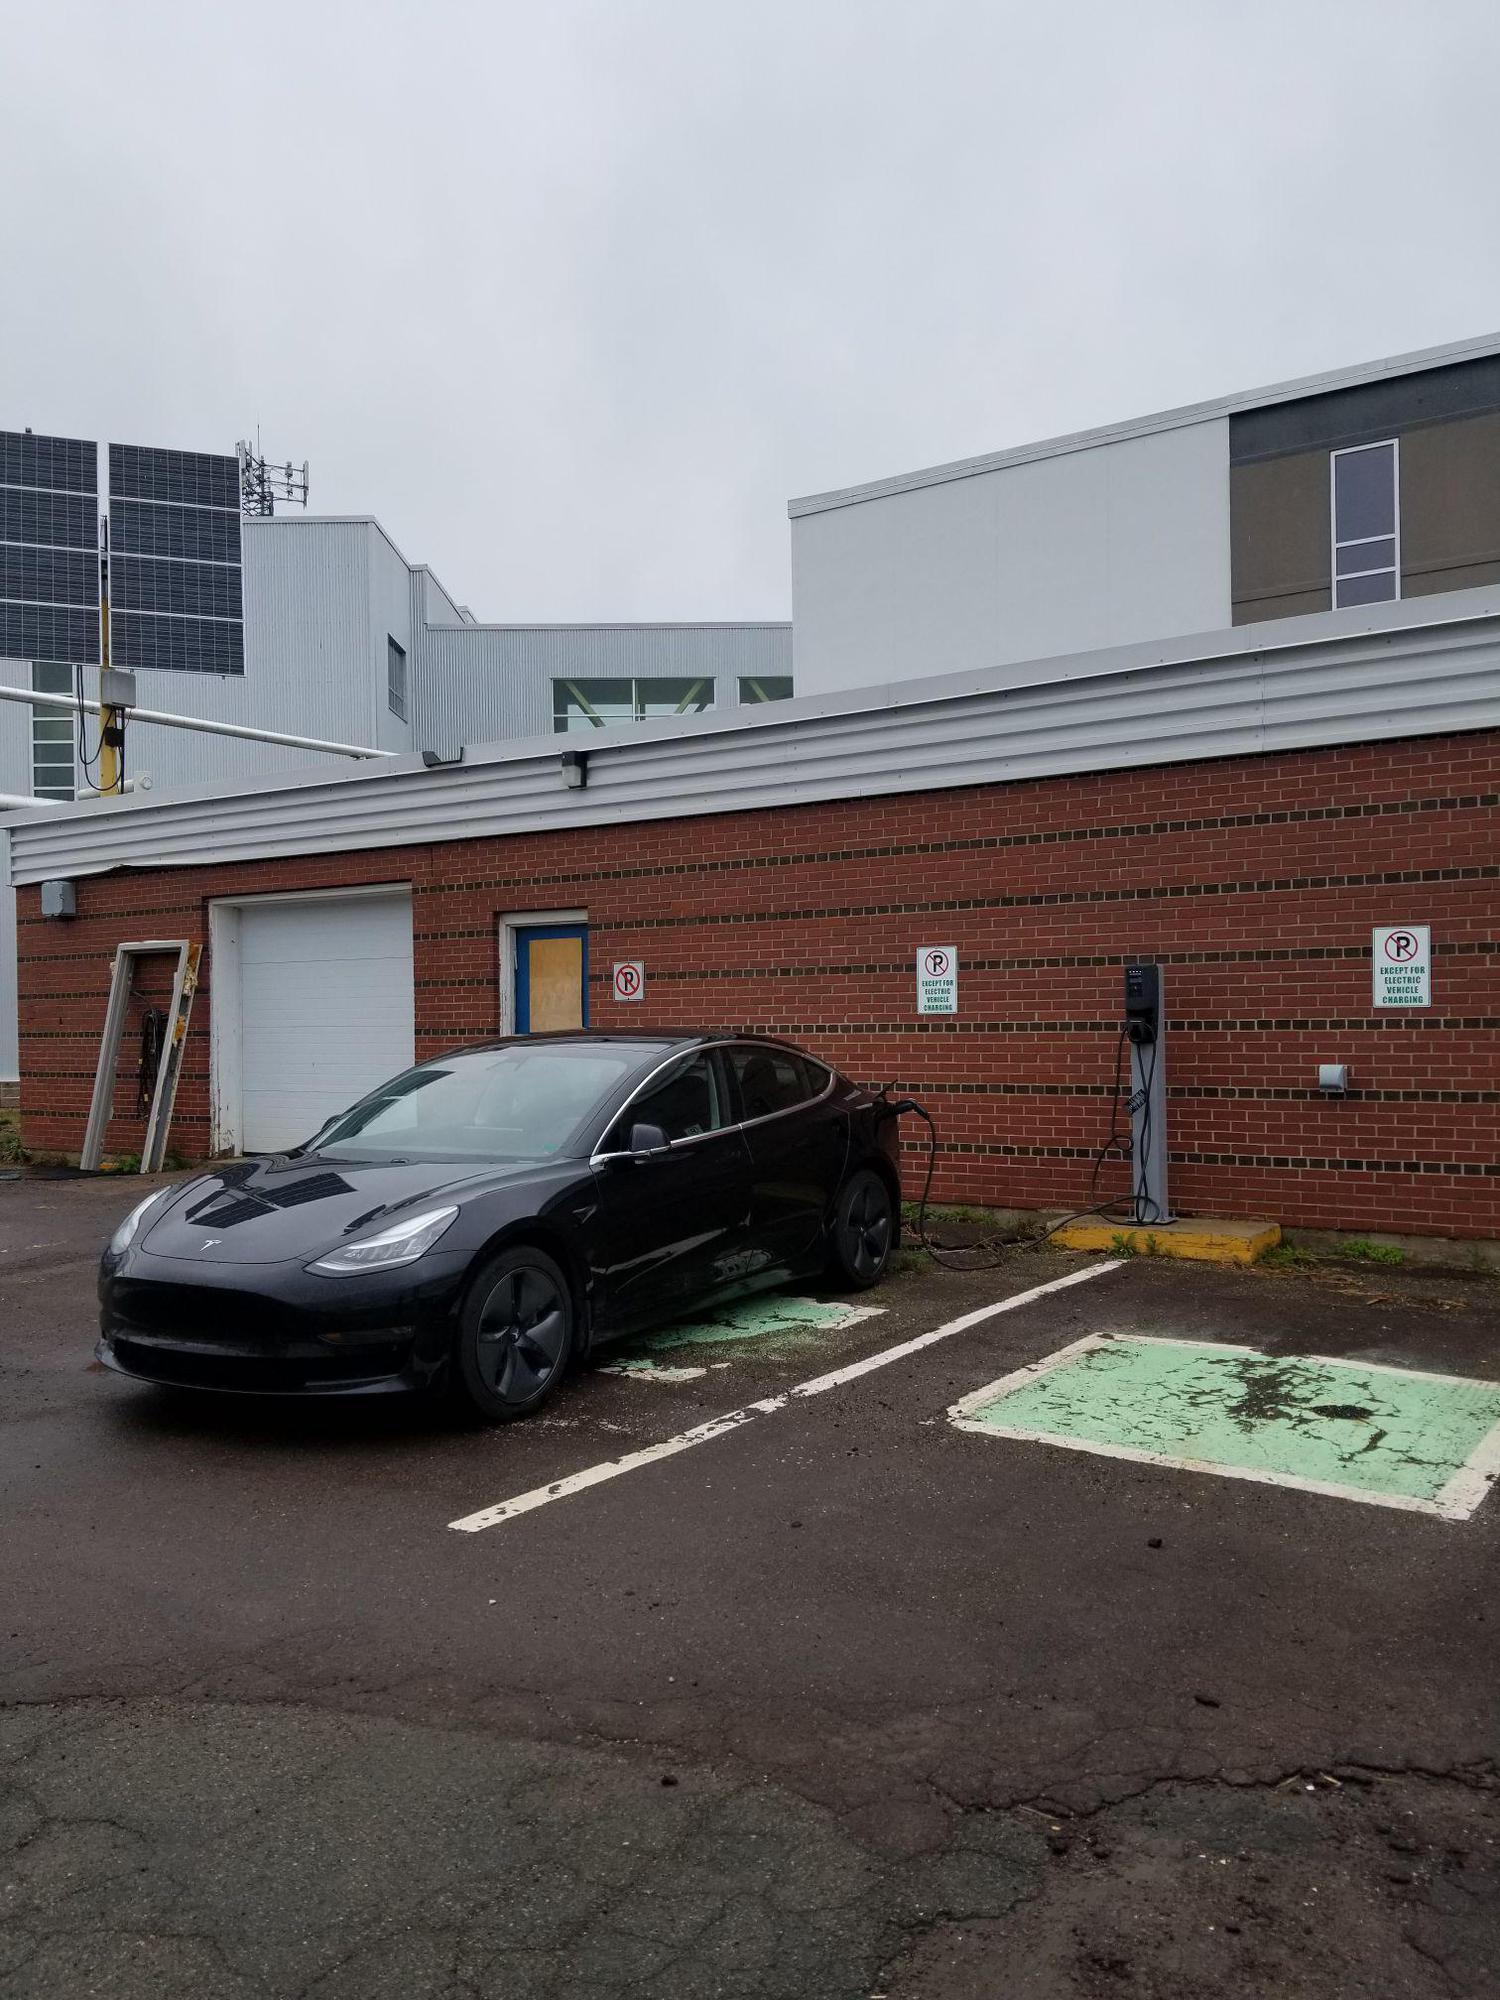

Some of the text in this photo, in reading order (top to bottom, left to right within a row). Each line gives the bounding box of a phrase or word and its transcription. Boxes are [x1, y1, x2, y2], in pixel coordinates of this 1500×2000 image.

[1380, 966, 1425, 975] EXCEPT FOR
[1384, 976, 1421, 984] ELECTRIC
[1386, 986, 1419, 994] VEHICLE
[1382, 995, 1423, 1004] CHARGING
